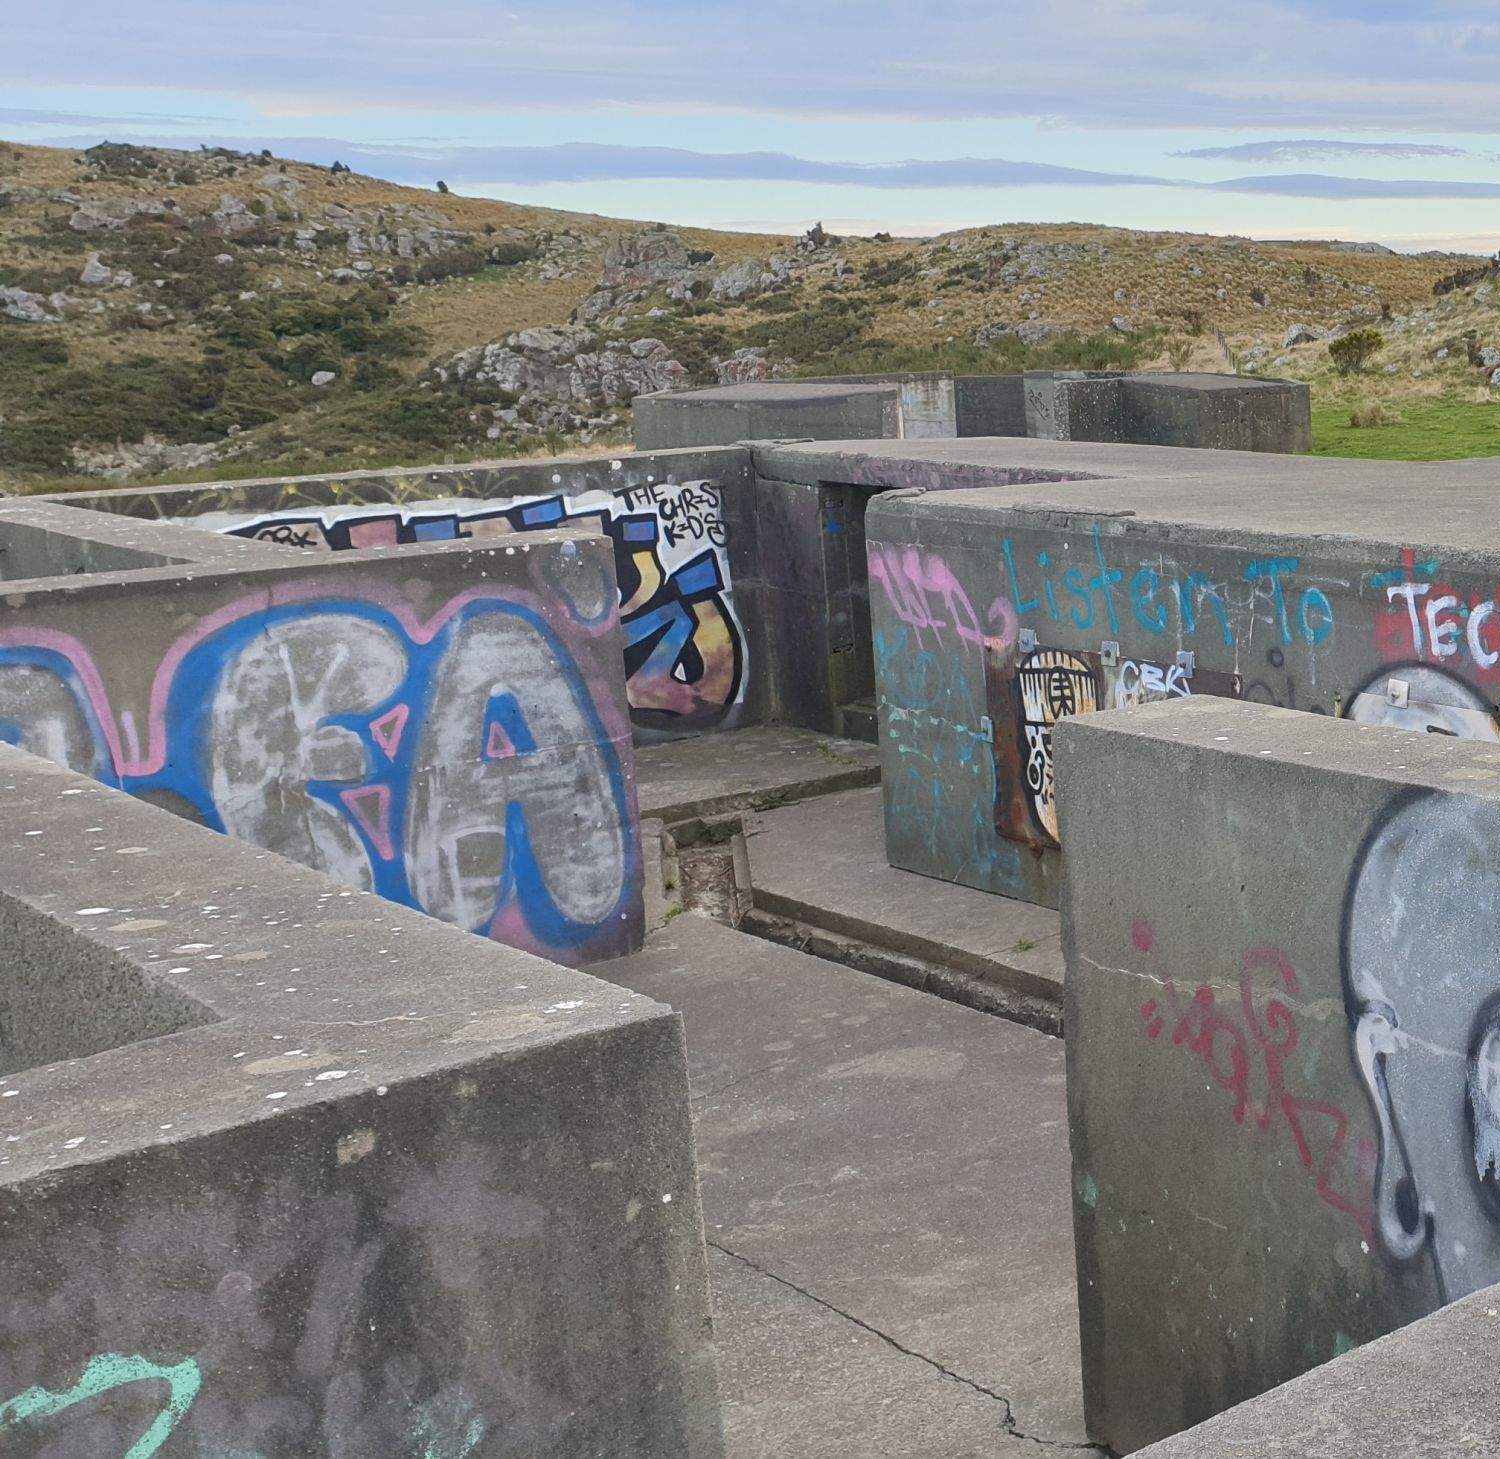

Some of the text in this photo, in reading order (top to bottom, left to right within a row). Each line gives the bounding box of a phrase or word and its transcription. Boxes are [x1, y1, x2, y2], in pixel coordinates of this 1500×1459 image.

[612, 480, 666, 512] THE
[1002, 527, 1233, 647] Listen
[1245, 557, 1333, 648] To
[1115, 660, 1191, 709] CBK
